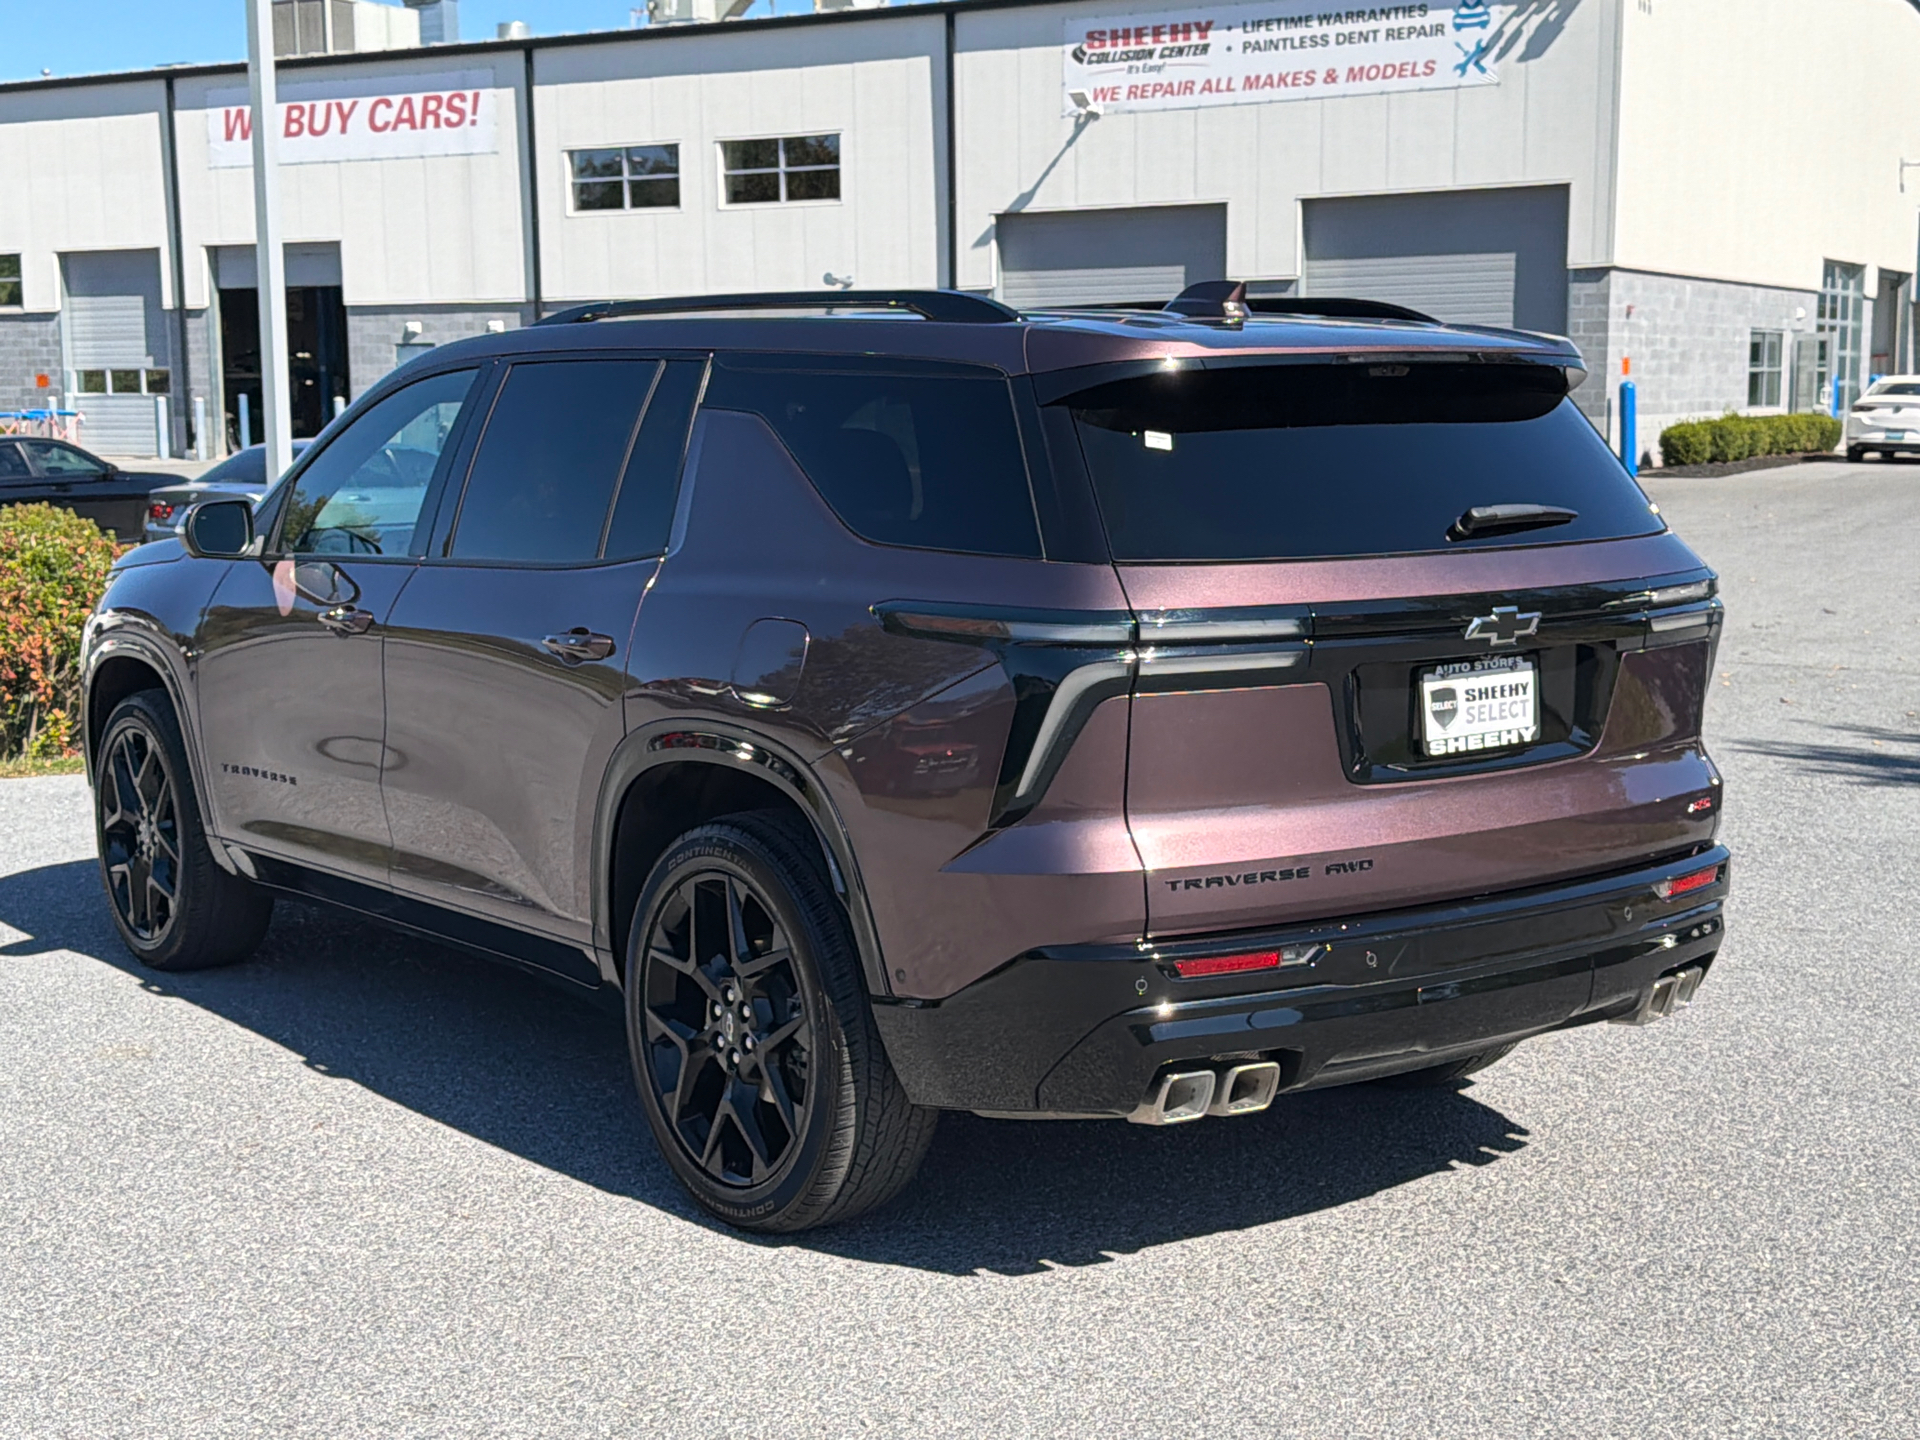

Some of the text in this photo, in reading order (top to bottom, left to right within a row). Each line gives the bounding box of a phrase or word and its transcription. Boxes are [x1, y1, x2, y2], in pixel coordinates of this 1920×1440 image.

[1242, 4, 1428, 34] LIFETIME WARRANTIES
[1086, 20, 1214, 49] SHEEHY
[1242, 23, 1445, 54] PAINTLESS DENT REPAIR
[1086, 43, 1211, 65] COLLISION CENTER
[1126, 62, 1167, 74] It's Easy!
[1092, 59, 1437, 102] WE REPAIR ALL MAKES & MODELS
[223, 91, 480, 142] W BUY CARS!
[1434, 662, 1471, 677] AUTO
[1431, 700, 1457, 712] SELECT
[1465, 681, 1529, 702] SHEEHY
[1465, 699, 1530, 725] SELECT
[1429, 725, 1538, 756] SHEEHY
[221, 762, 297, 786] TRAVERSE
[667, 846, 756, 879] CONTINENTAL
[1165, 859, 1374, 891] TRAVERSE AWD
